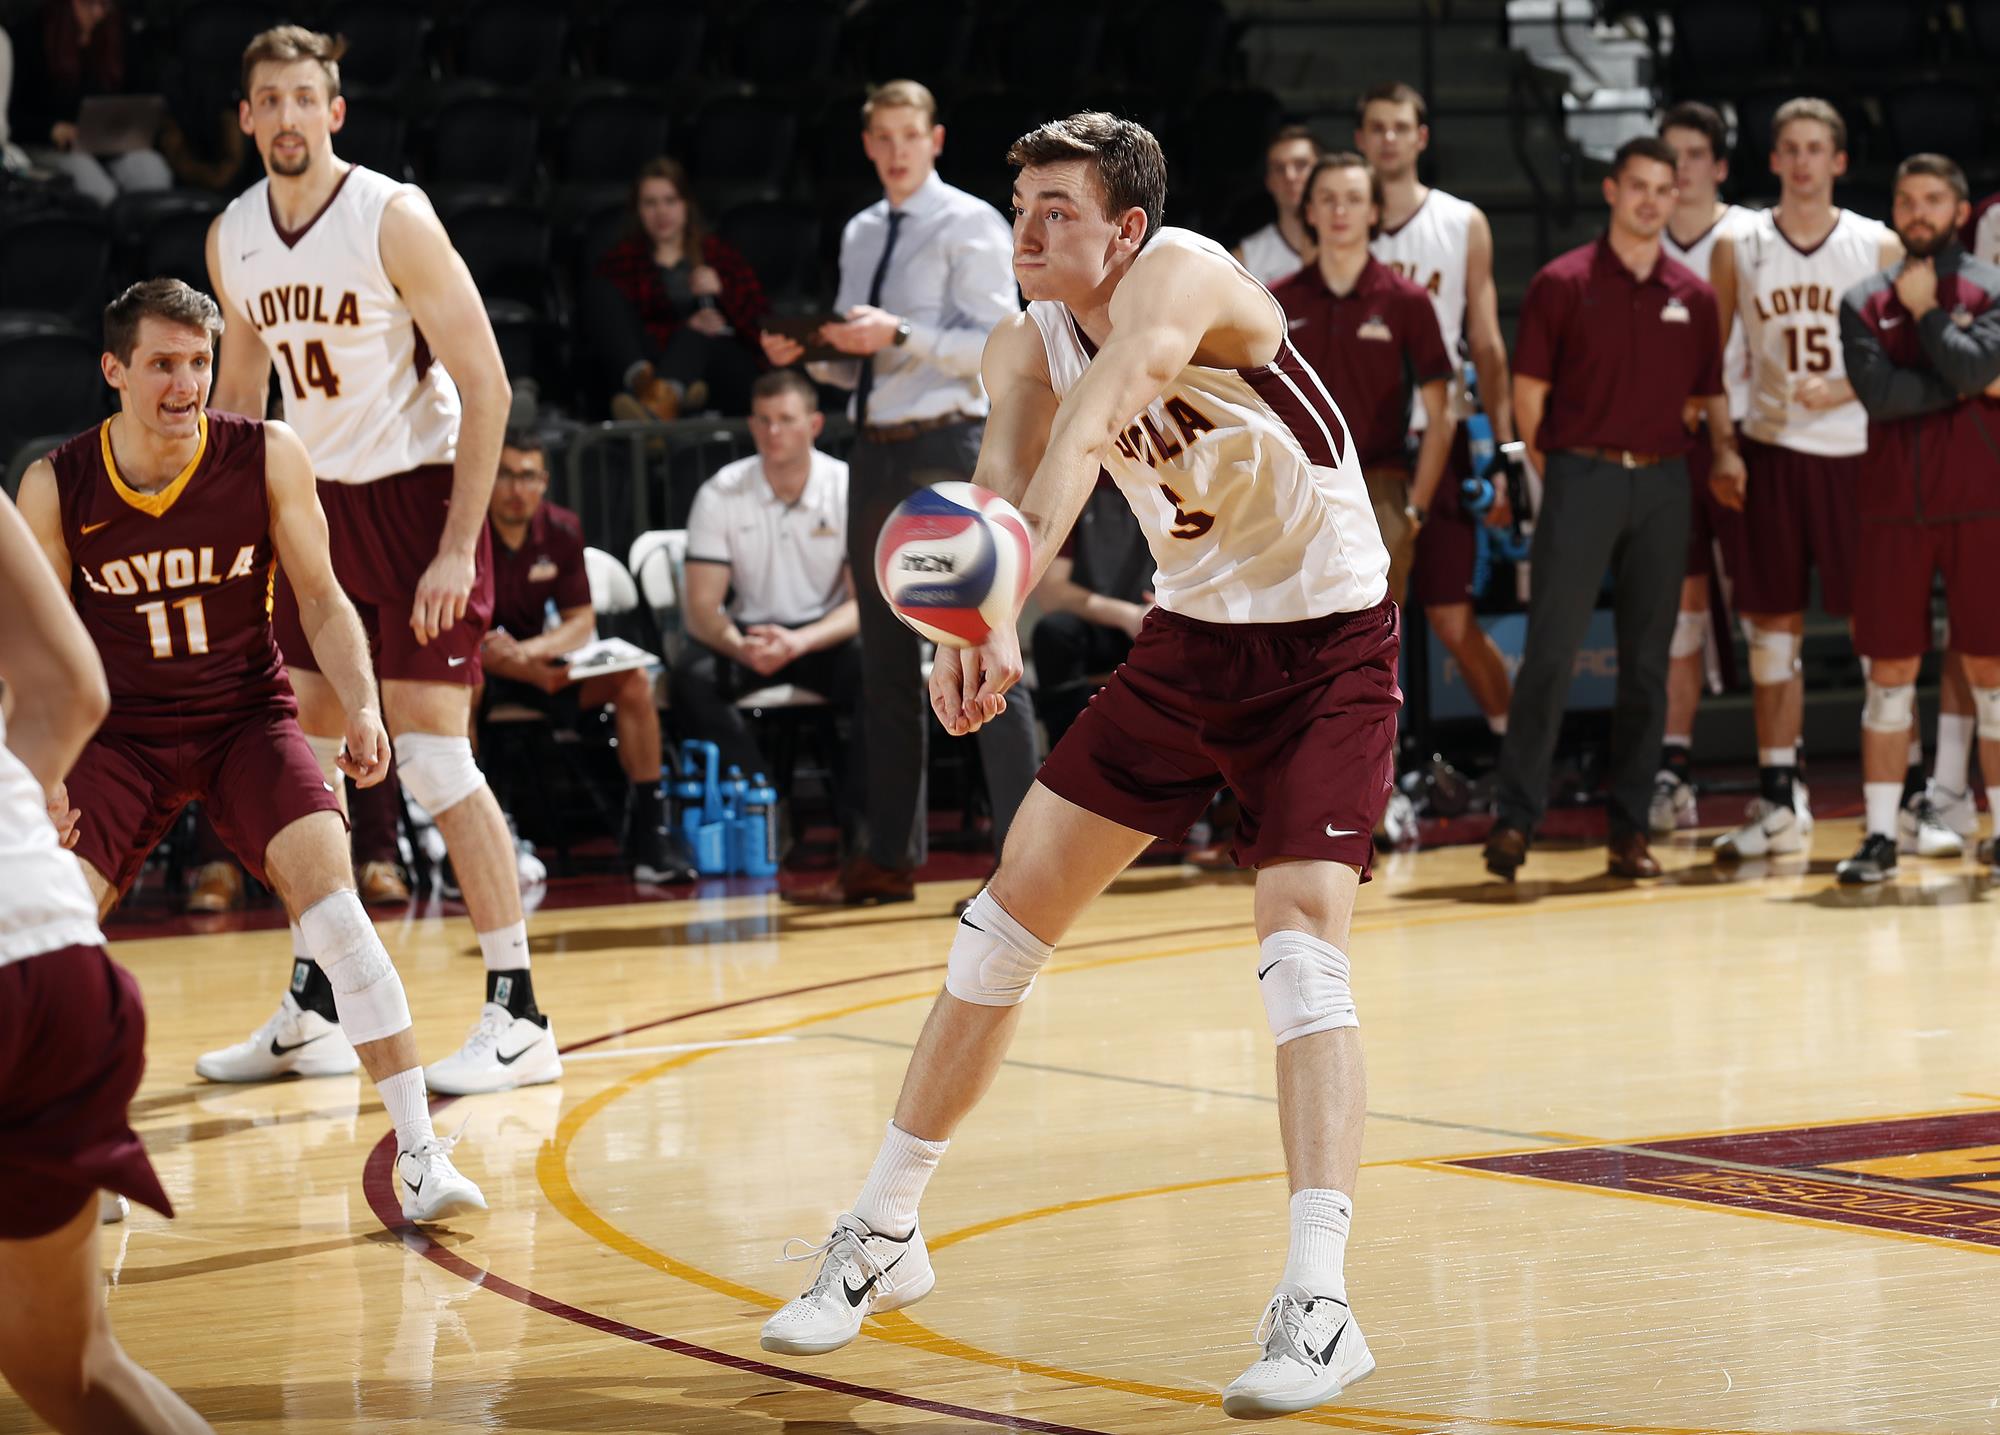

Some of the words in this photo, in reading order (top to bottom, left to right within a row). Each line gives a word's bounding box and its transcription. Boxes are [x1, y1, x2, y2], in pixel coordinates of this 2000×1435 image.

[244, 284, 361, 331] LOYOLA
[1753, 284, 1836, 321] LOYOL
[277, 340, 341, 400] 14
[1784, 326, 1832, 373] 15
[1114, 395, 1217, 468] YOLA
[80, 544, 256, 596] LOYOLA
[135, 596, 209, 659] 11
